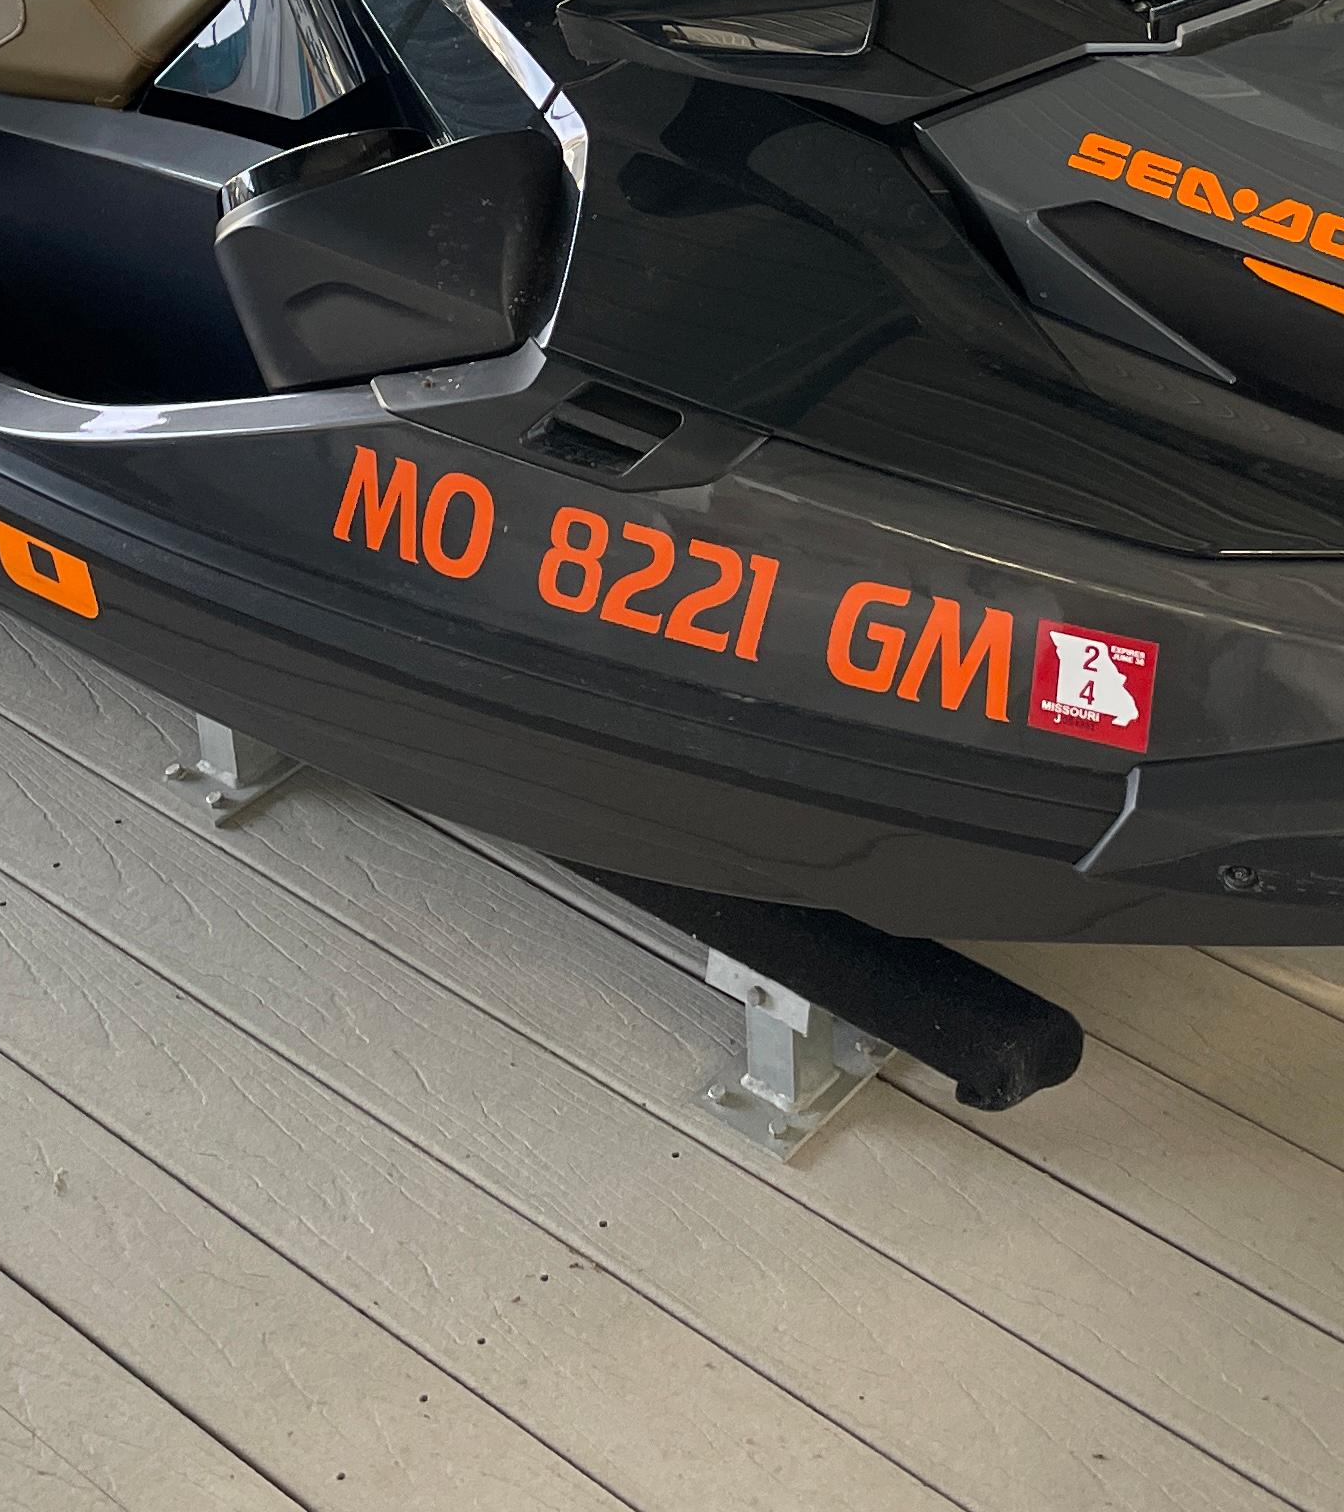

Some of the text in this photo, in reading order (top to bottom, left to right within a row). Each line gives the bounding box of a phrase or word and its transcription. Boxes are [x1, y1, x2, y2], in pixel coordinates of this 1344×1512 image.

[332, 445, 1014, 723] MO 8221 GM
[1082, 645, 1100, 672] 2
[1078, 679, 1096, 705] 4
[1041, 699, 1100, 723] MISSOURI
